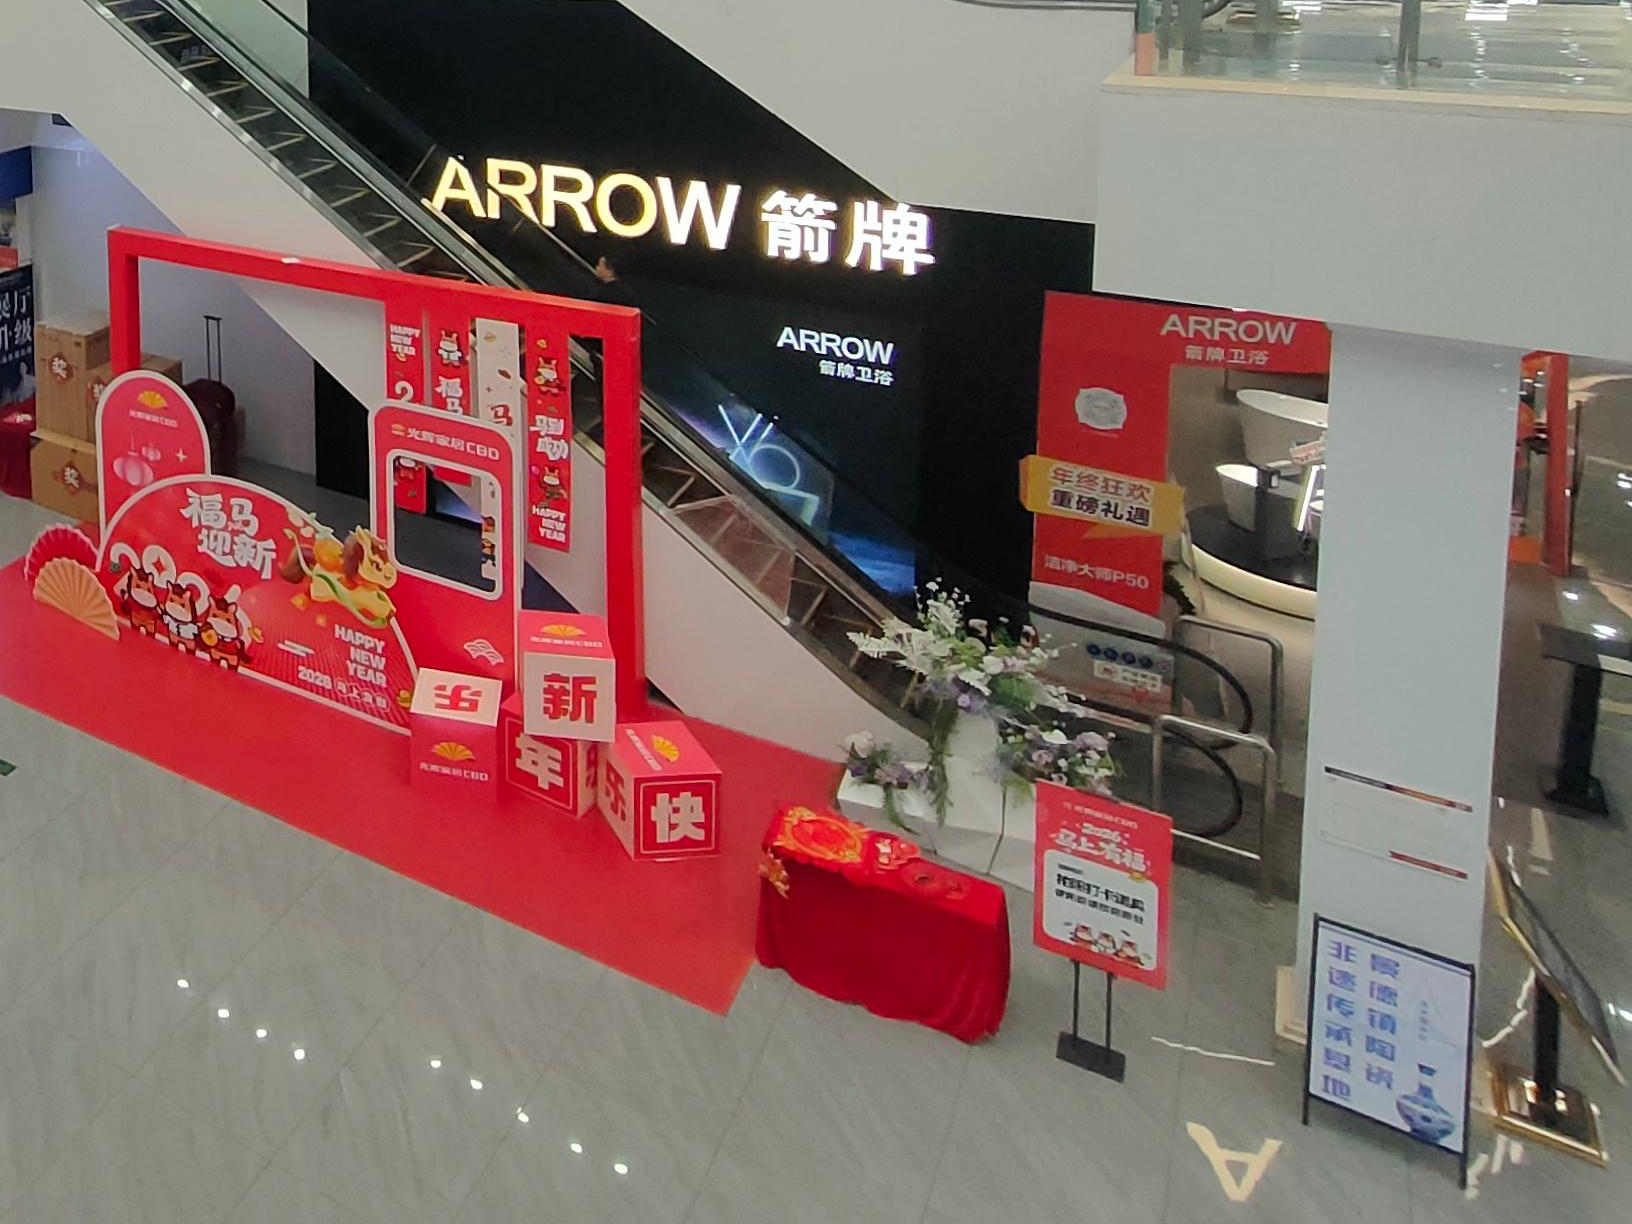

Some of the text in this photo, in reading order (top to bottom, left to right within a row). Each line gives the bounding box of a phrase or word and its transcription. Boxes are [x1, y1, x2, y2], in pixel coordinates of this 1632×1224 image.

[431, 156, 936, 275] ARROW 箭牌
[390, 324, 421, 339] HAPPY
[777, 326, 894, 365] ARROW
[1160, 313, 1296, 345] ARROW
[818, 359, 894, 385] 箭牌卫浴
[1185, 344, 1269, 365] 箭牌卫浴
[1050, 466, 1152, 504] 年终狂欢
[532, 504, 567, 521] HAPPY
[1051, 488, 1151, 527] 重磅礼遇
[198, 528, 277, 580] 迎新
[334, 623, 385, 654] HAPPY
[346, 660, 387, 688] YEAR
[350, 645, 386, 671] NEW
[543, 674, 597, 723] 新
[515, 733, 564, 790] 年
[651, 791, 705, 843] 快
